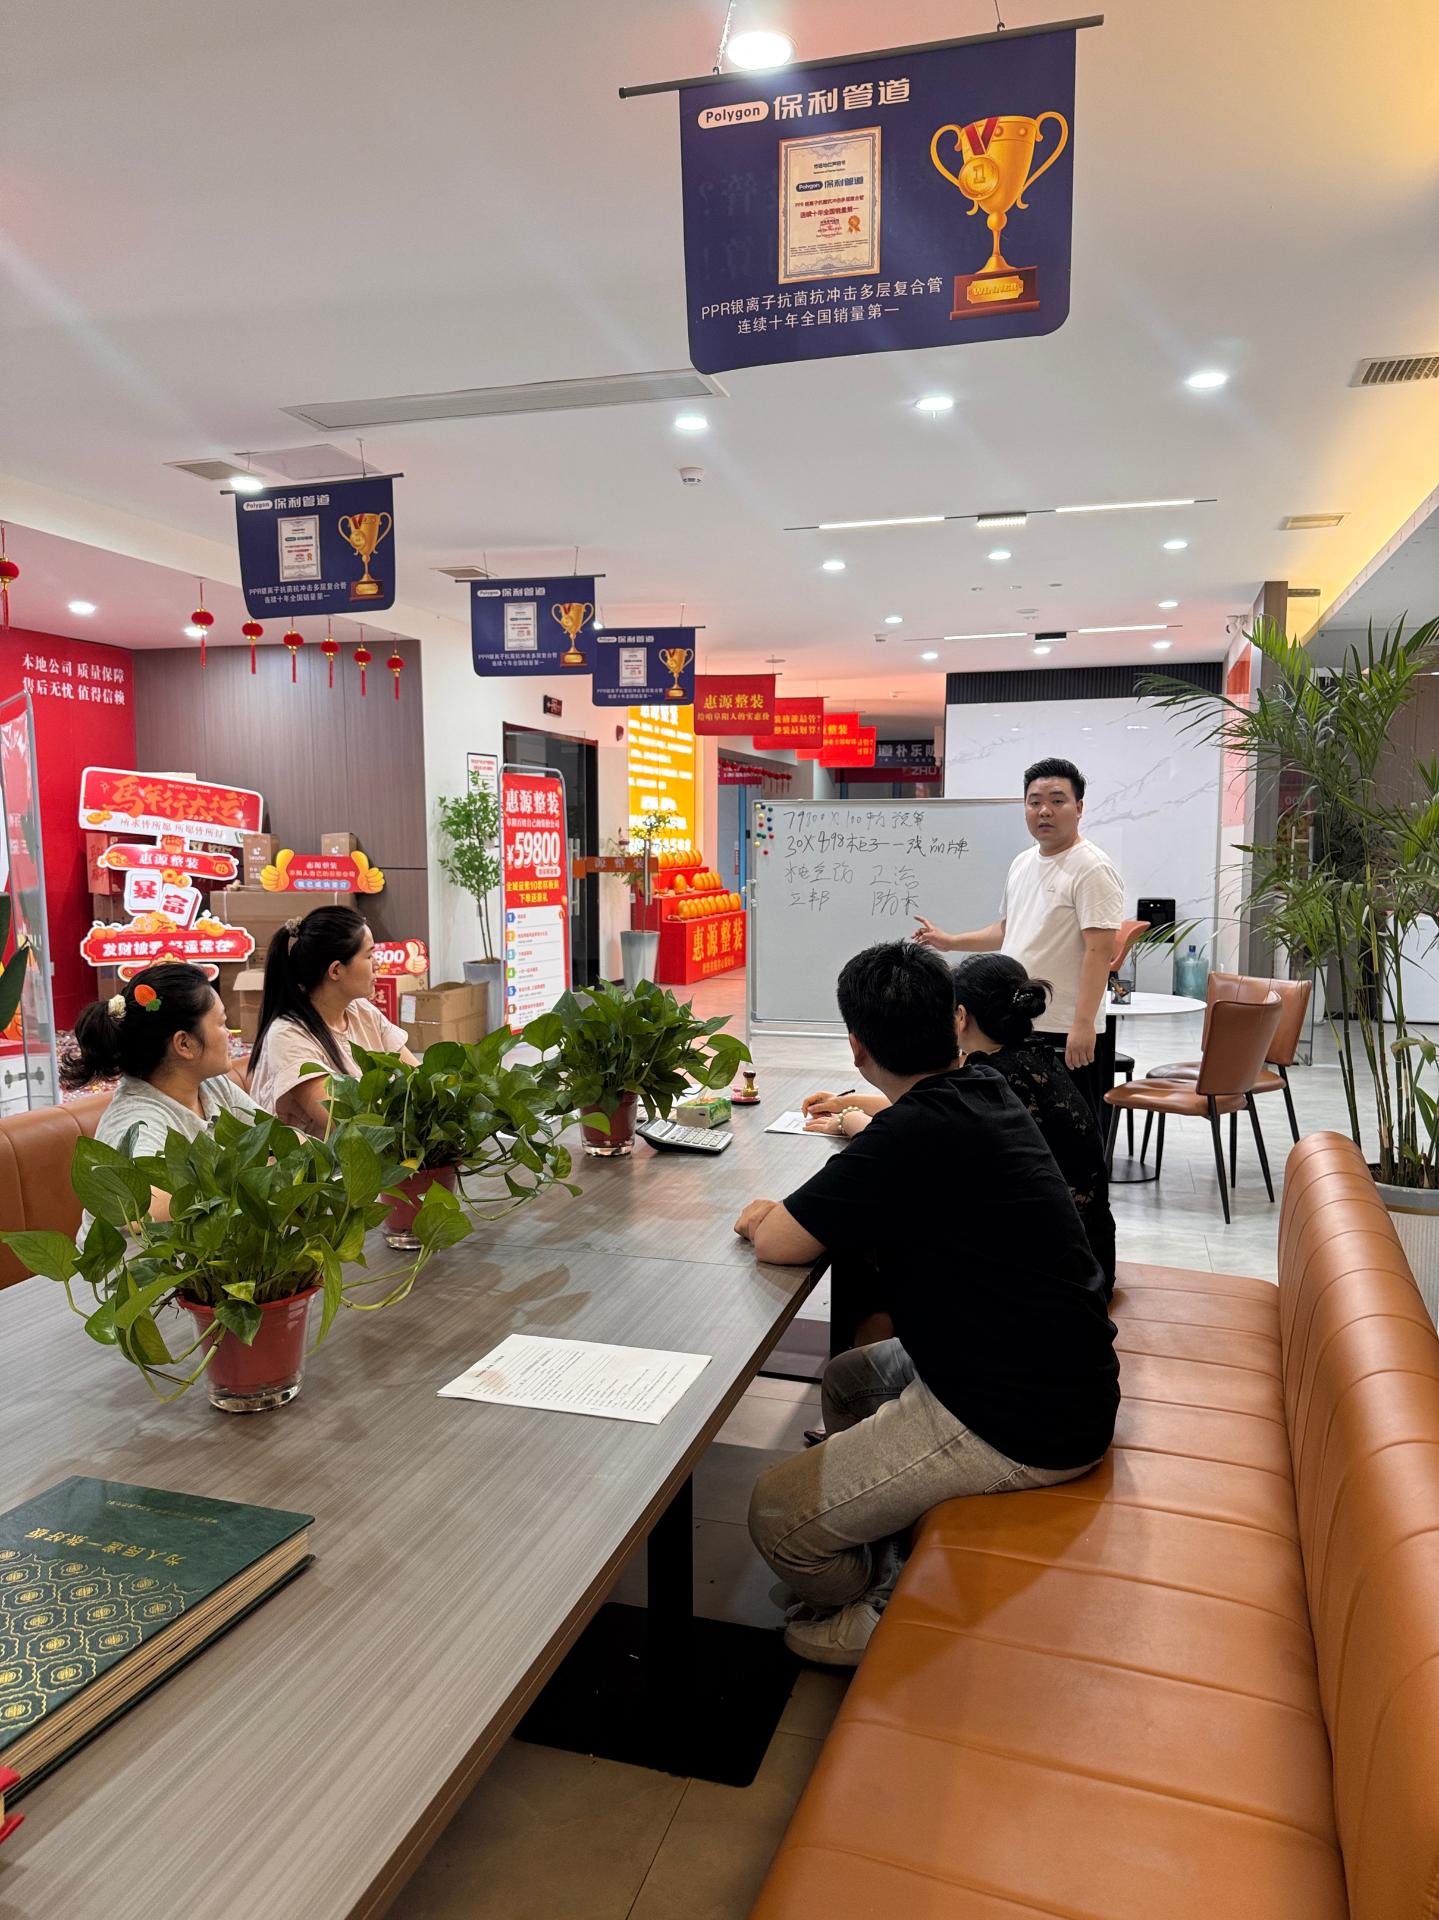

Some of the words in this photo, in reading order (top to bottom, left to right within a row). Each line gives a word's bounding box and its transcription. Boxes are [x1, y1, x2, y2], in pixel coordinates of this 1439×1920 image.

[706, 106, 760, 123] Polygon
[773, 78, 910, 120] 保利管道
[701, 276, 943, 320] PPR银离子抗菌抗冲击多层复合管
[737, 303, 899, 335] 连续十年全国销量第一
[274, 494, 330, 509] 保利管道
[23, 653, 72, 677] 本地公司
[78, 663, 124, 684] 质量保障
[23, 677, 74, 700] 售后无忧
[78, 684, 125, 705] 值得信赖
[704, 694, 764, 710] 惠源整装
[506, 788, 560, 814] 惠源整装
[139, 852, 200, 870] 惠源整装
[507, 832, 560, 869] ¥59800
[871, 889, 919, 916] 防水
[692, 917, 743, 961] 惠源整装
